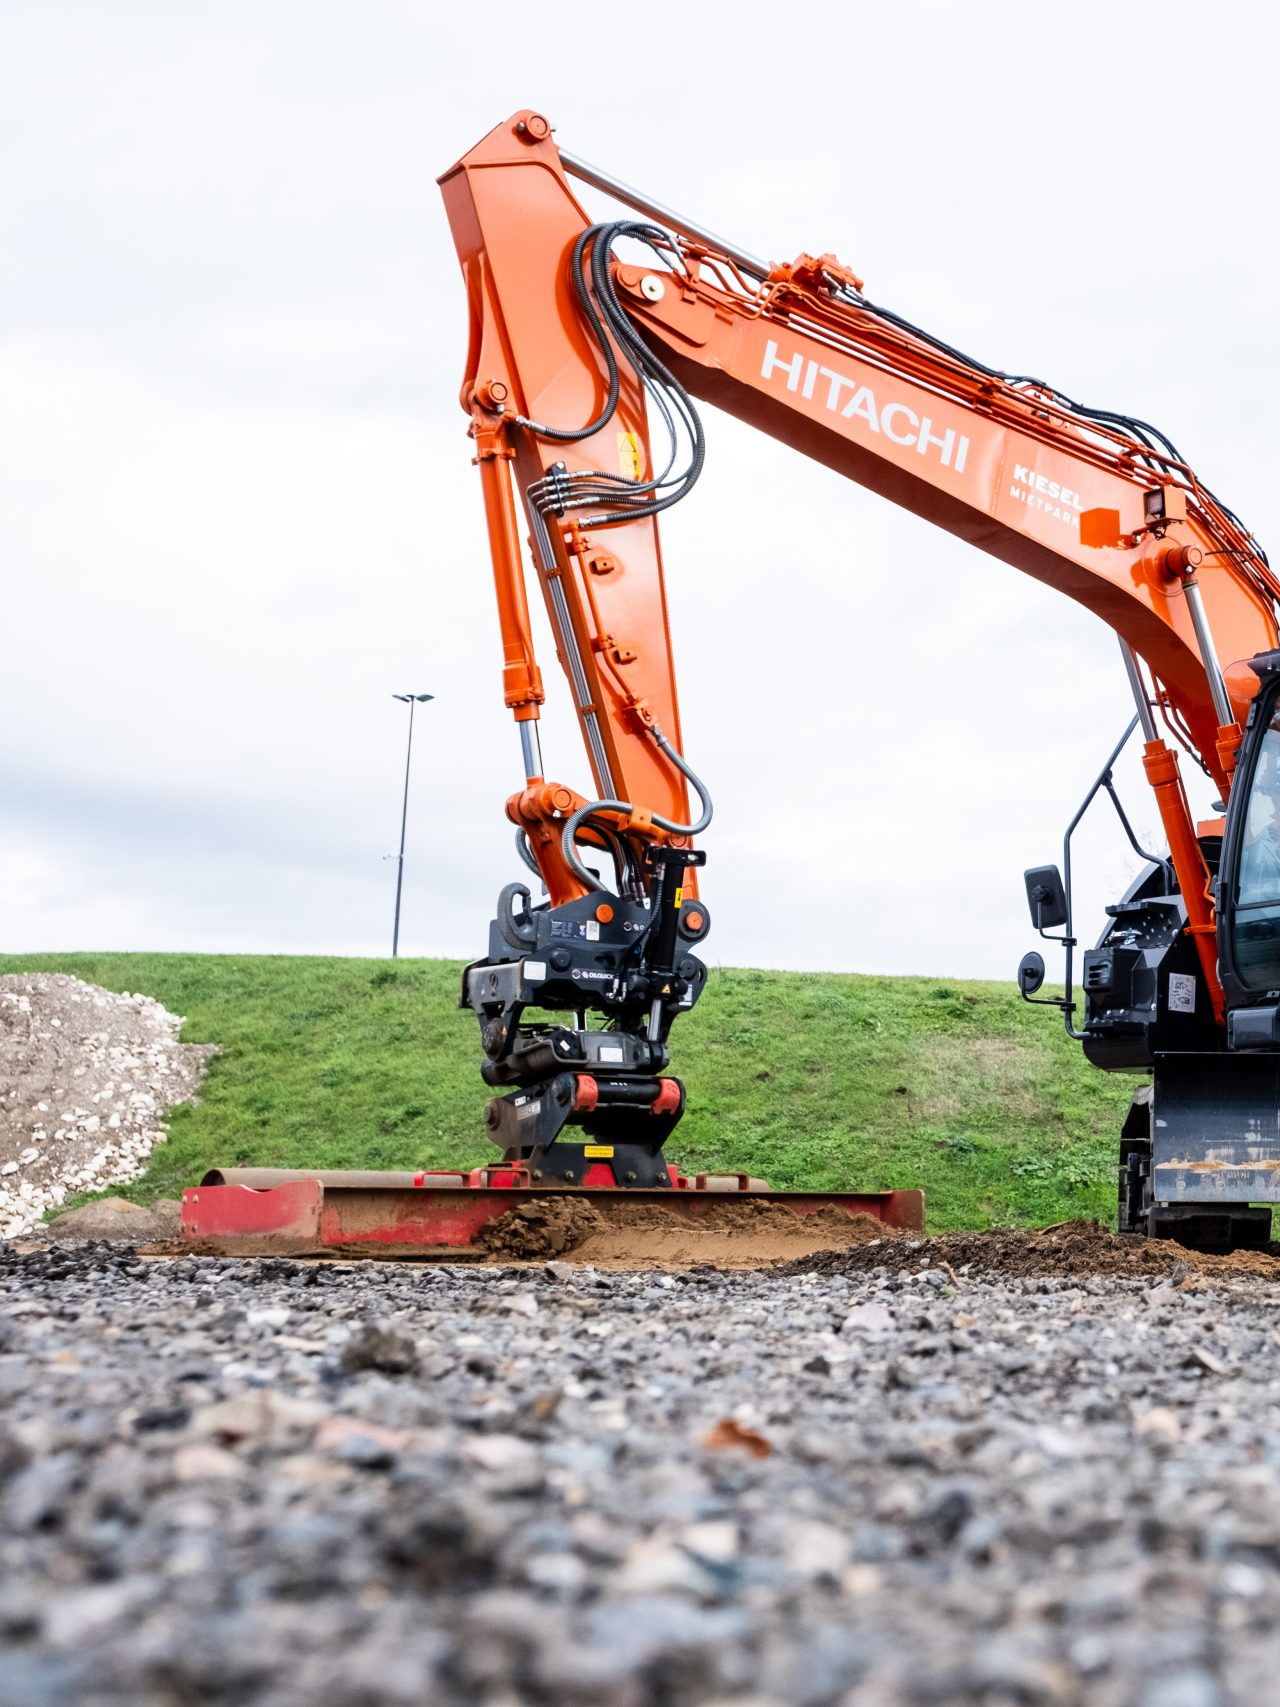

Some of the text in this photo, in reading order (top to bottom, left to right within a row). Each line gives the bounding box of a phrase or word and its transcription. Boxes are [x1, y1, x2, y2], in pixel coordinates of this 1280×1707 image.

[760, 339, 970, 473] HITACHI
[1010, 486, 1080, 528] MIETPARK
[1013, 463, 1084, 512] KIESEL
